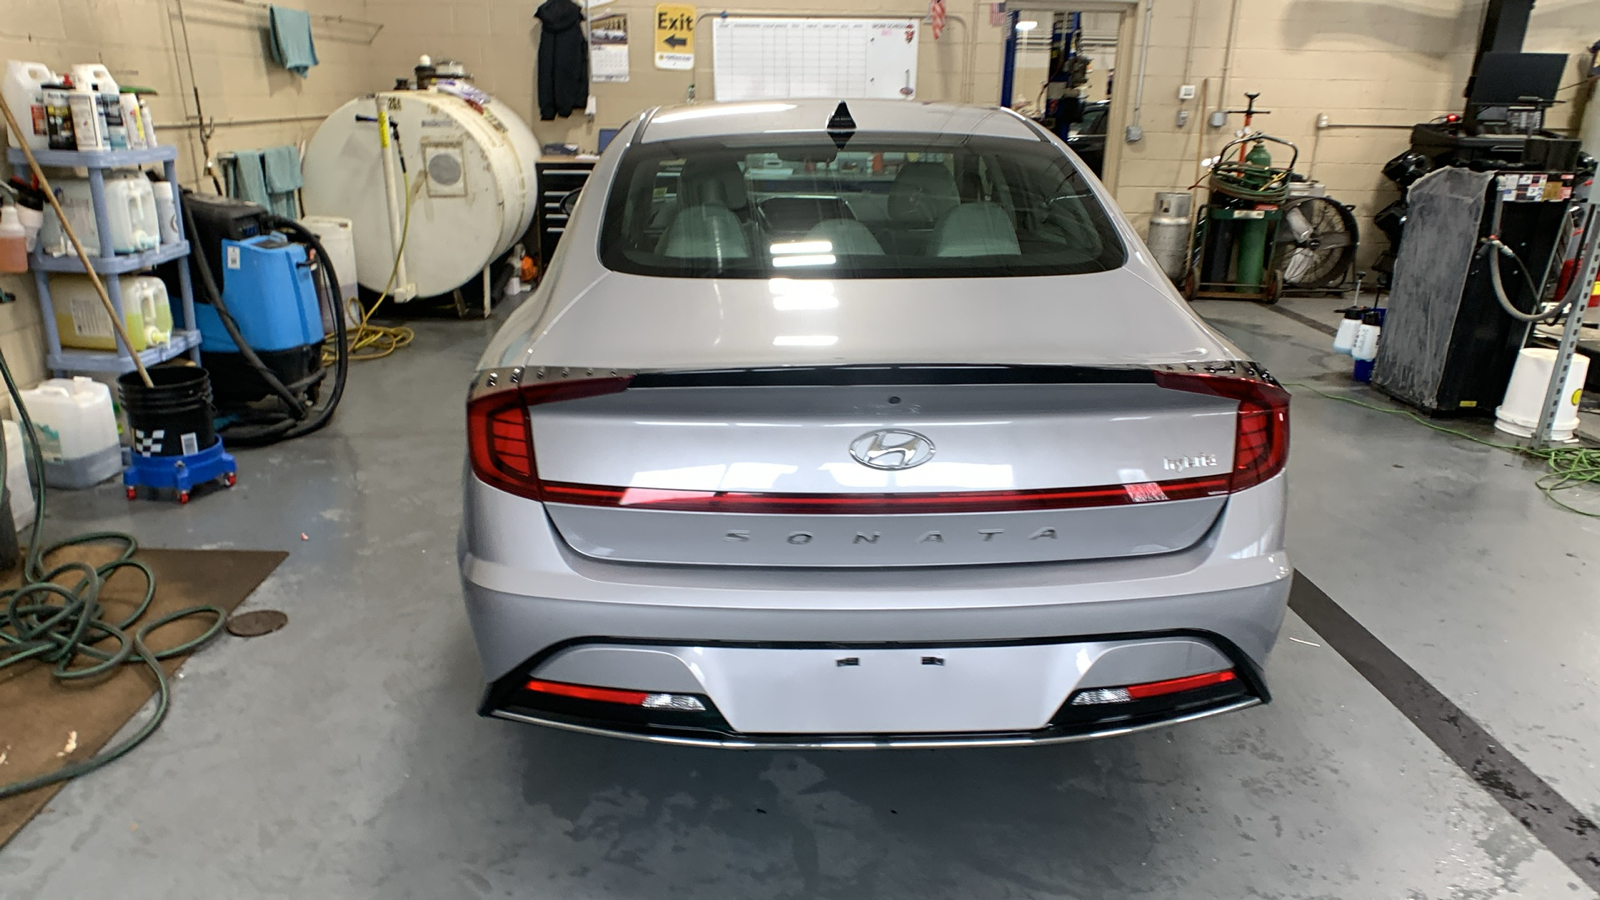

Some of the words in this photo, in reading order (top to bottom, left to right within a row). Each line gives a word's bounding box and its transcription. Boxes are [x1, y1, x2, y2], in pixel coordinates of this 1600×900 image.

[658, 12, 694, 32] Exit
[1163, 452, 1218, 472] hybrid
[724, 527, 1058, 545] SONATA
